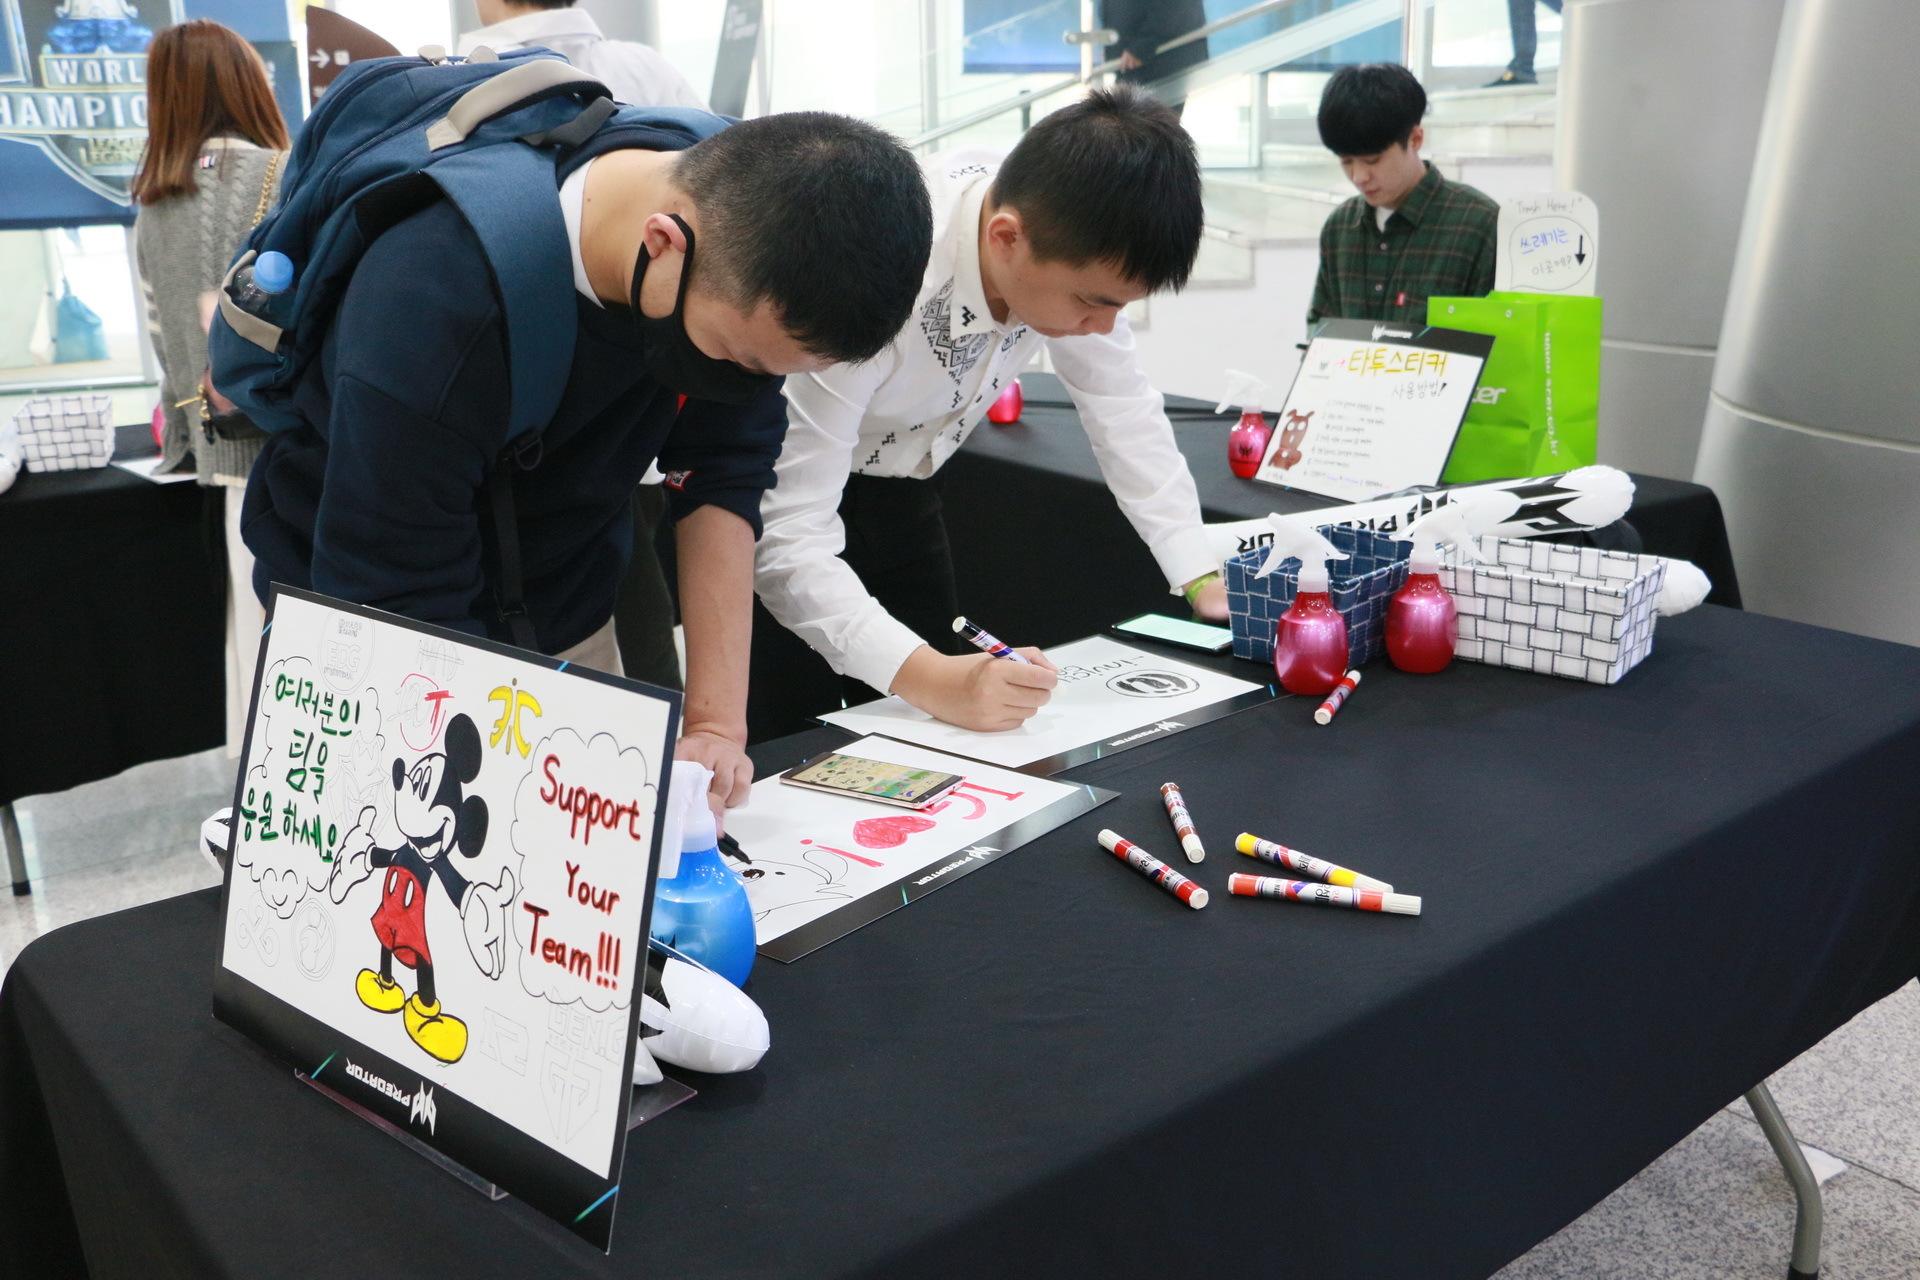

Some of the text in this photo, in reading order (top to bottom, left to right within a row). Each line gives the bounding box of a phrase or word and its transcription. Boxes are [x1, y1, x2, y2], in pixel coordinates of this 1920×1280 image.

[51, 58, 146, 85] WORL
[0, 94, 148, 129] HAMPIO
[1520, 228, 1569, 255] 쓰레기는
[1347, 346, 1449, 377] 타투스티커
[275, 673, 361, 737] 여러분의
[286, 728, 328, 805] 팀을
[539, 754, 641, 846] Support
[565, 859, 621, 916] Your
[912, 856, 974, 886] PREDATOR
[523, 900, 621, 991] Team!!!
[345, 1057, 411, 1108] PREDATOR
